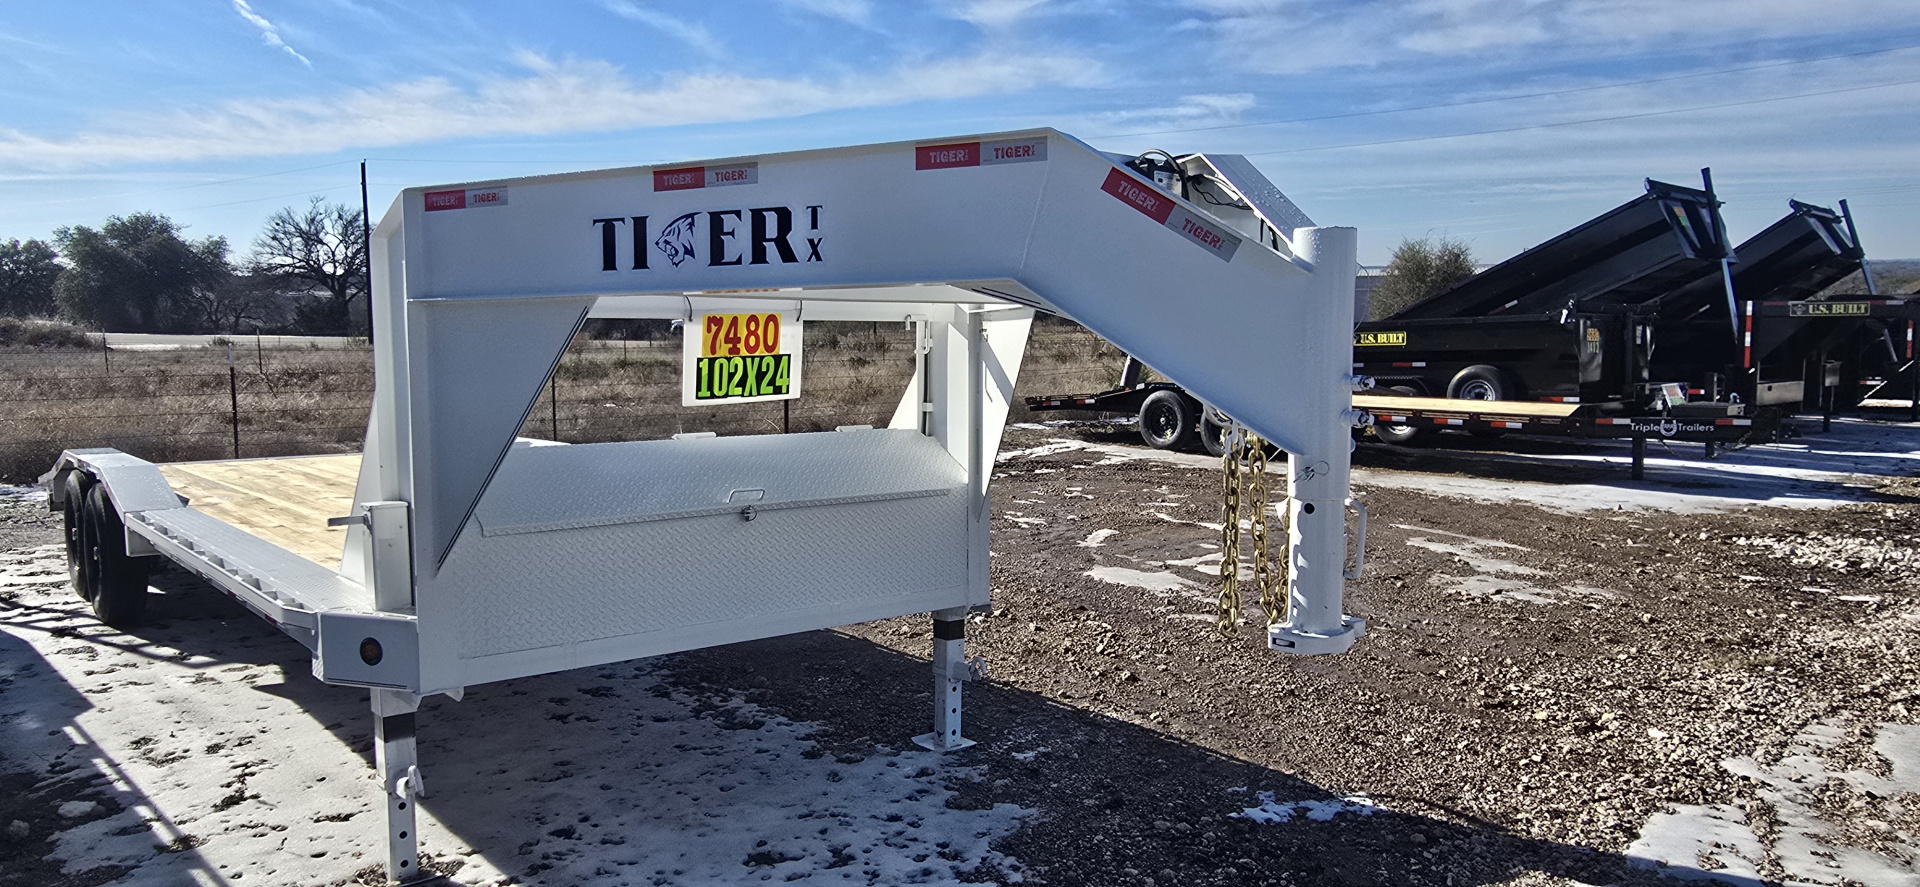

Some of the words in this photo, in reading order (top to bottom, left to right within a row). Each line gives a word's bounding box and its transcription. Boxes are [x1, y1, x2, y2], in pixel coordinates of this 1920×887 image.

[929, 149, 965, 164] TIGER
[993, 145, 1032, 159] TIGER
[663, 174, 692, 186] TIGER
[714, 170, 745, 183] TIGER
[433, 196, 456, 207] TIGER
[473, 192, 497, 203] TIGER
[1117, 179, 1157, 211] TIGER
[1181, 217, 1221, 249] TIGER
[1808, 304, 1830, 314] U.S.
[1832, 304, 1867, 314] BUILT
[706, 313, 780, 356] 7480
[1360, 333, 1376, 344] U.S.
[1377, 333, 1404, 343] BUILT
[697, 355, 790, 398] 102X24
[1630, 422, 1660, 433] Triple
[1677, 422, 1715, 432] Trailers
